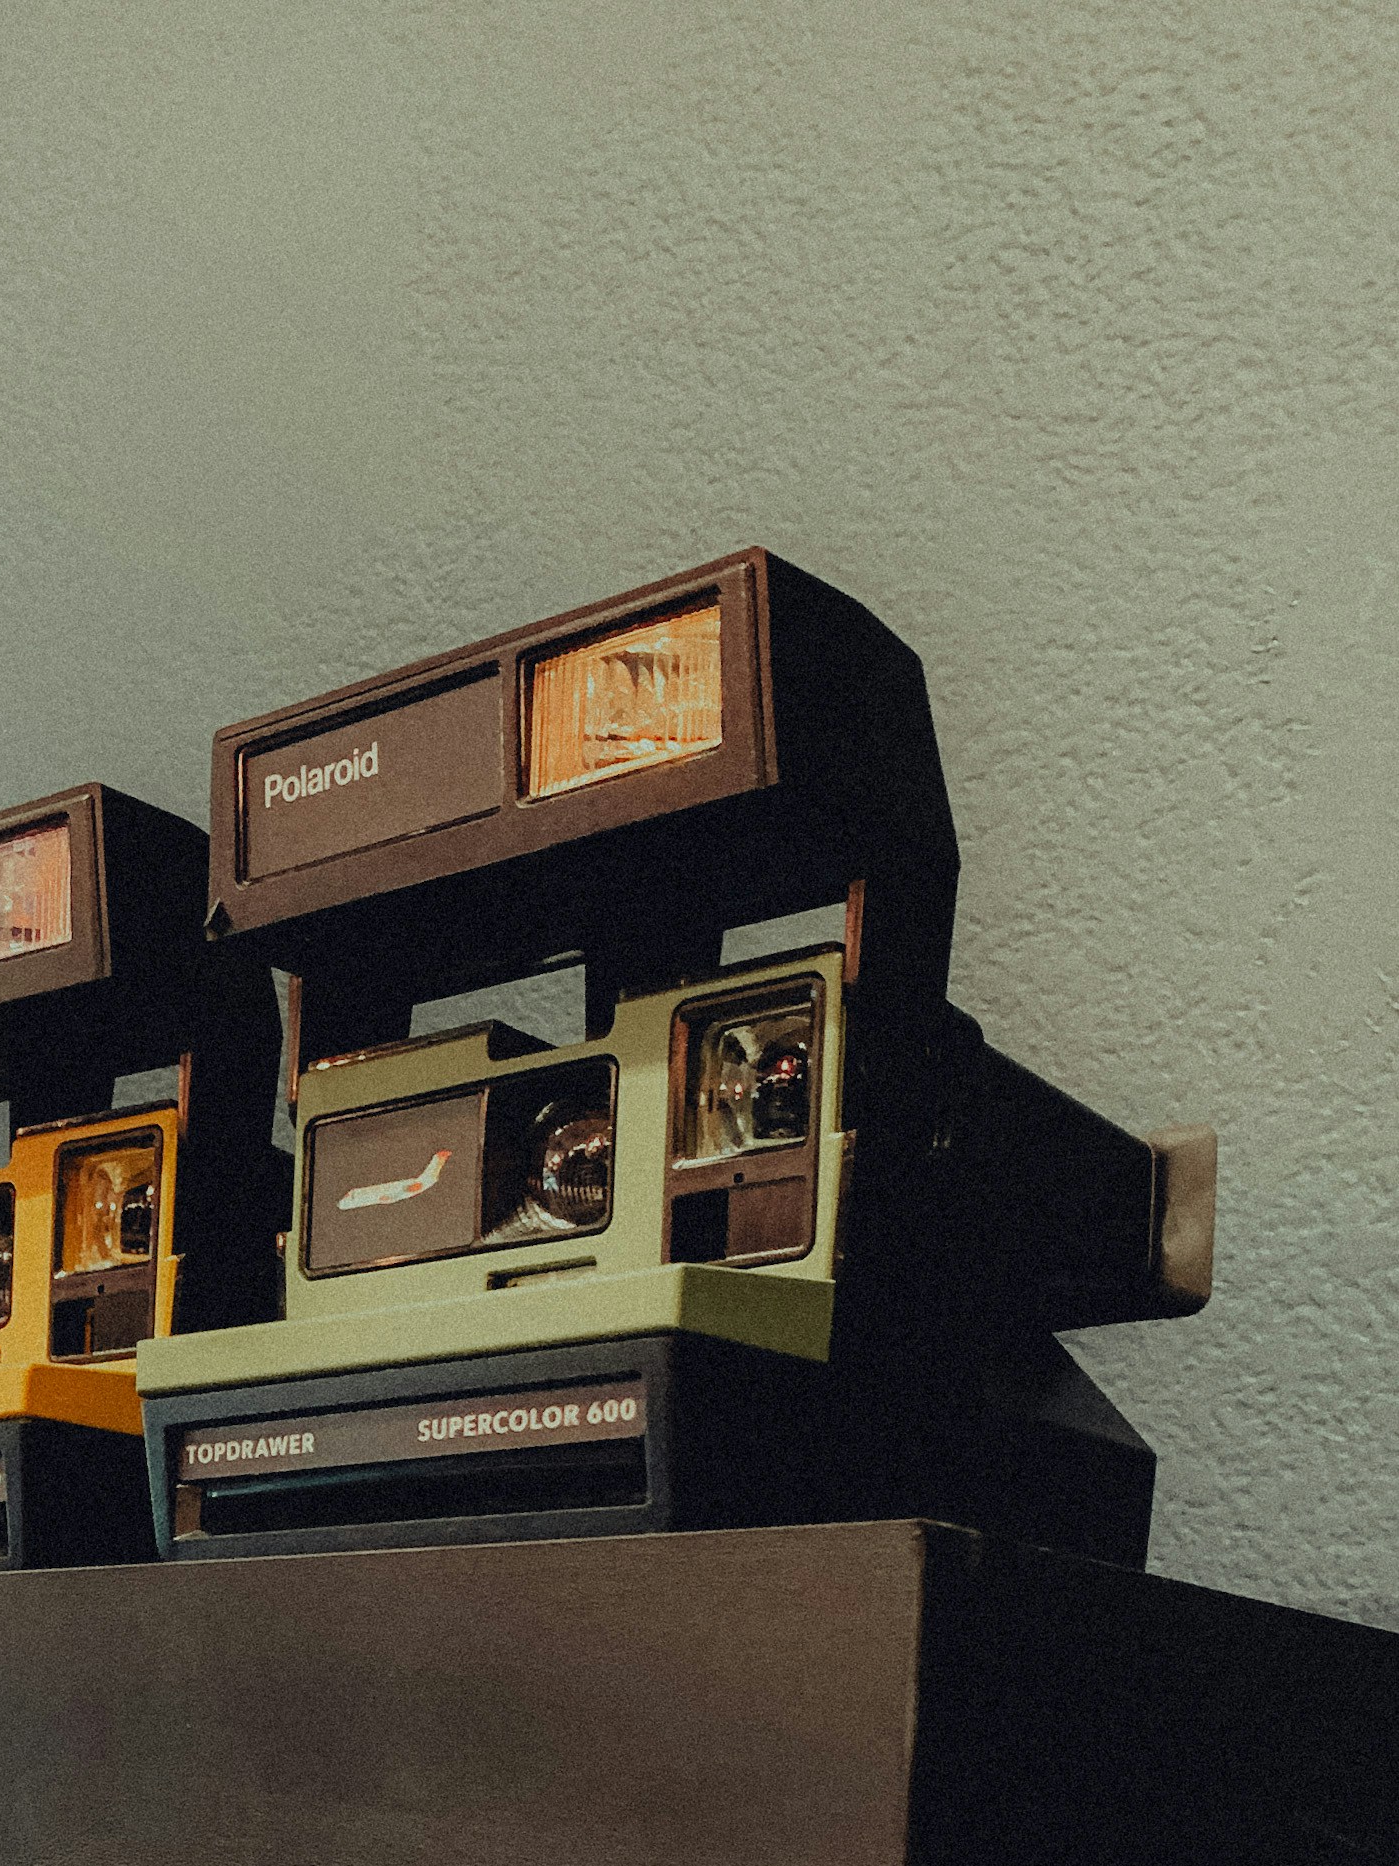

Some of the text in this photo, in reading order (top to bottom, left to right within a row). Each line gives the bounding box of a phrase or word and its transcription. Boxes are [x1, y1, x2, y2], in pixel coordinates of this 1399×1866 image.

[264, 741, 379, 809] Polaroid
[186, 1397, 637, 1464] TOPDRAWER SUPERCOLOR 600
